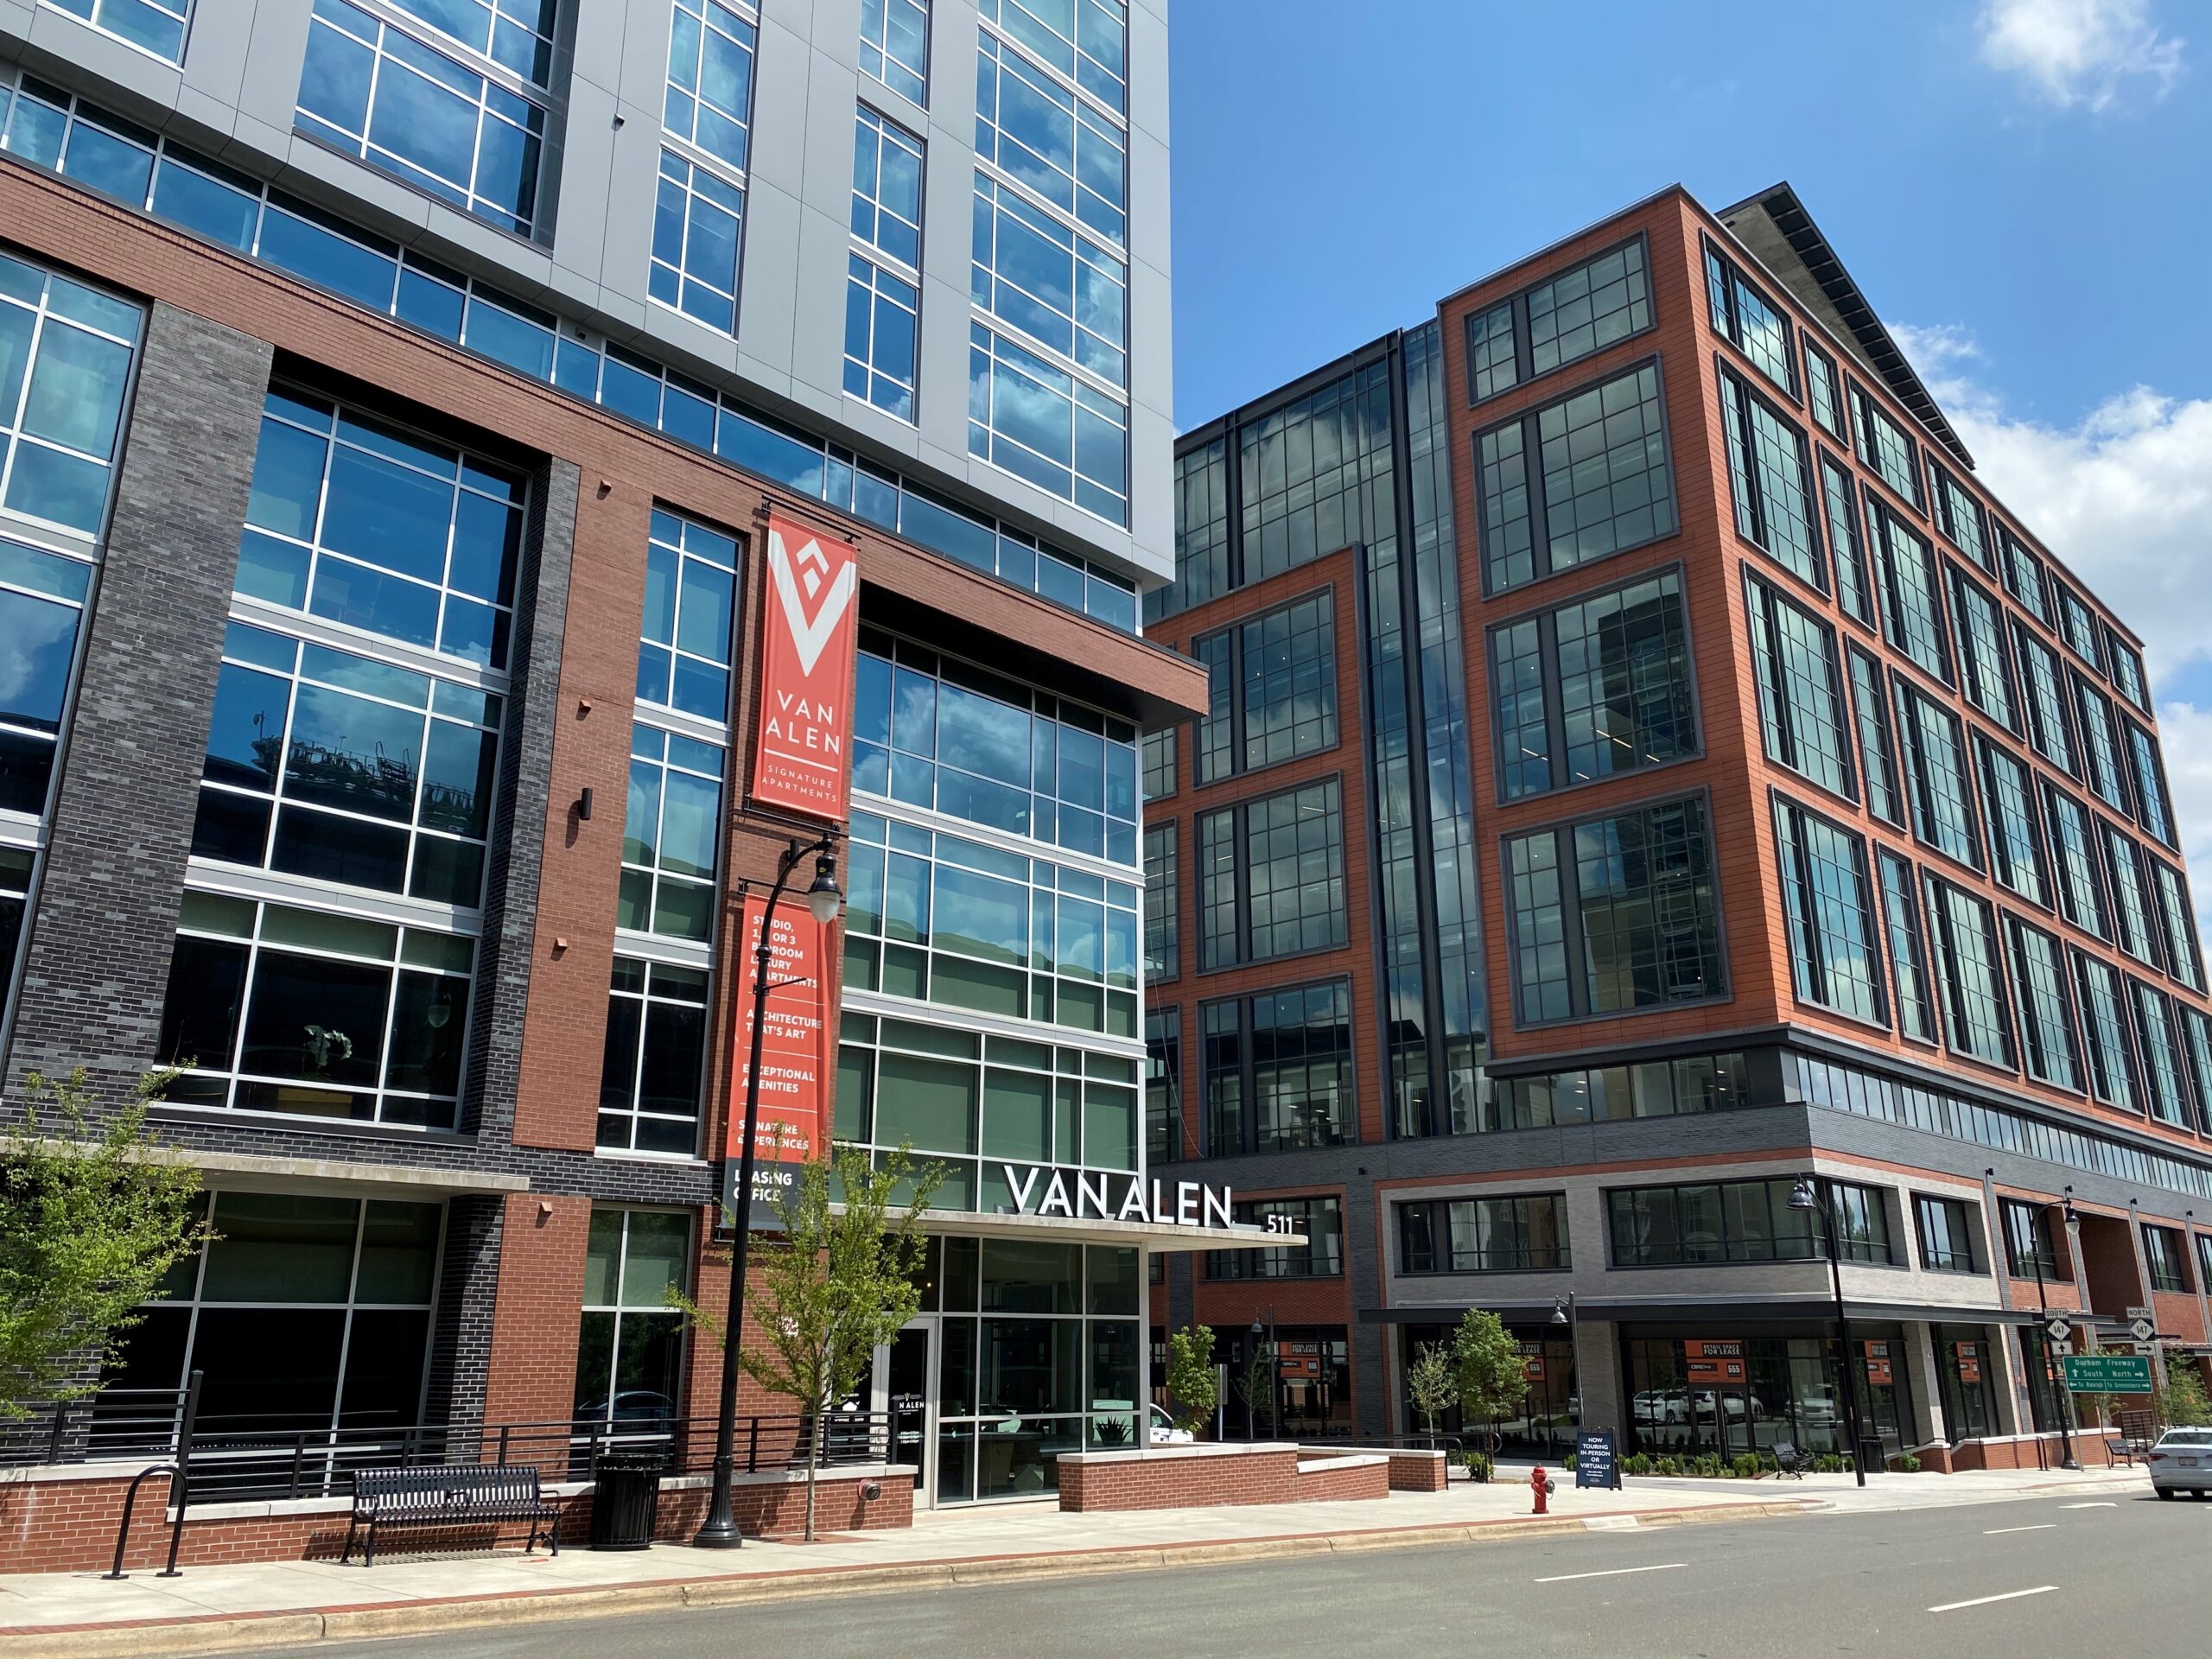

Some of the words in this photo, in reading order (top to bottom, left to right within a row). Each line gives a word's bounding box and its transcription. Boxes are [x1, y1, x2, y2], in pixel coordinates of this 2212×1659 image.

[777, 690, 833, 726] VAN
[766, 716, 840, 755] ALEN
[767, 765, 833, 789] SIGNATURE
[762, 777, 837, 802] APARTMENTS
[753, 915, 794, 932] STDIO,
[772, 932, 788, 944] OR
[790, 936, 796, 945] 3
[751, 941, 804, 960] BROOM
[750, 955, 791, 970] LURY
[749, 969, 817, 989] ARTMENTS
[746, 1008, 823, 1029] AHITECTURE
[746, 1022, 783, 1036] TAT'S
[785, 1028, 807, 1039] ART
[742, 1063, 816, 1082] EEPTIONAL
[741, 1077, 798, 1093] AENITIES
[738, 1119, 798, 1135] SNATRE
[734, 1169, 792, 1186] LASING
[733, 1186, 781, 1202] OFICE
[1003, 1165, 1108, 1219] VAN
[1117, 1176, 1231, 1230] ALEN
[1268, 1214, 1293, 1235] 511
[2053, 1325, 2064, 1334] 147
[2136, 1325, 2147, 1334] 147
[2107, 1359, 2136, 1368] Freeway
